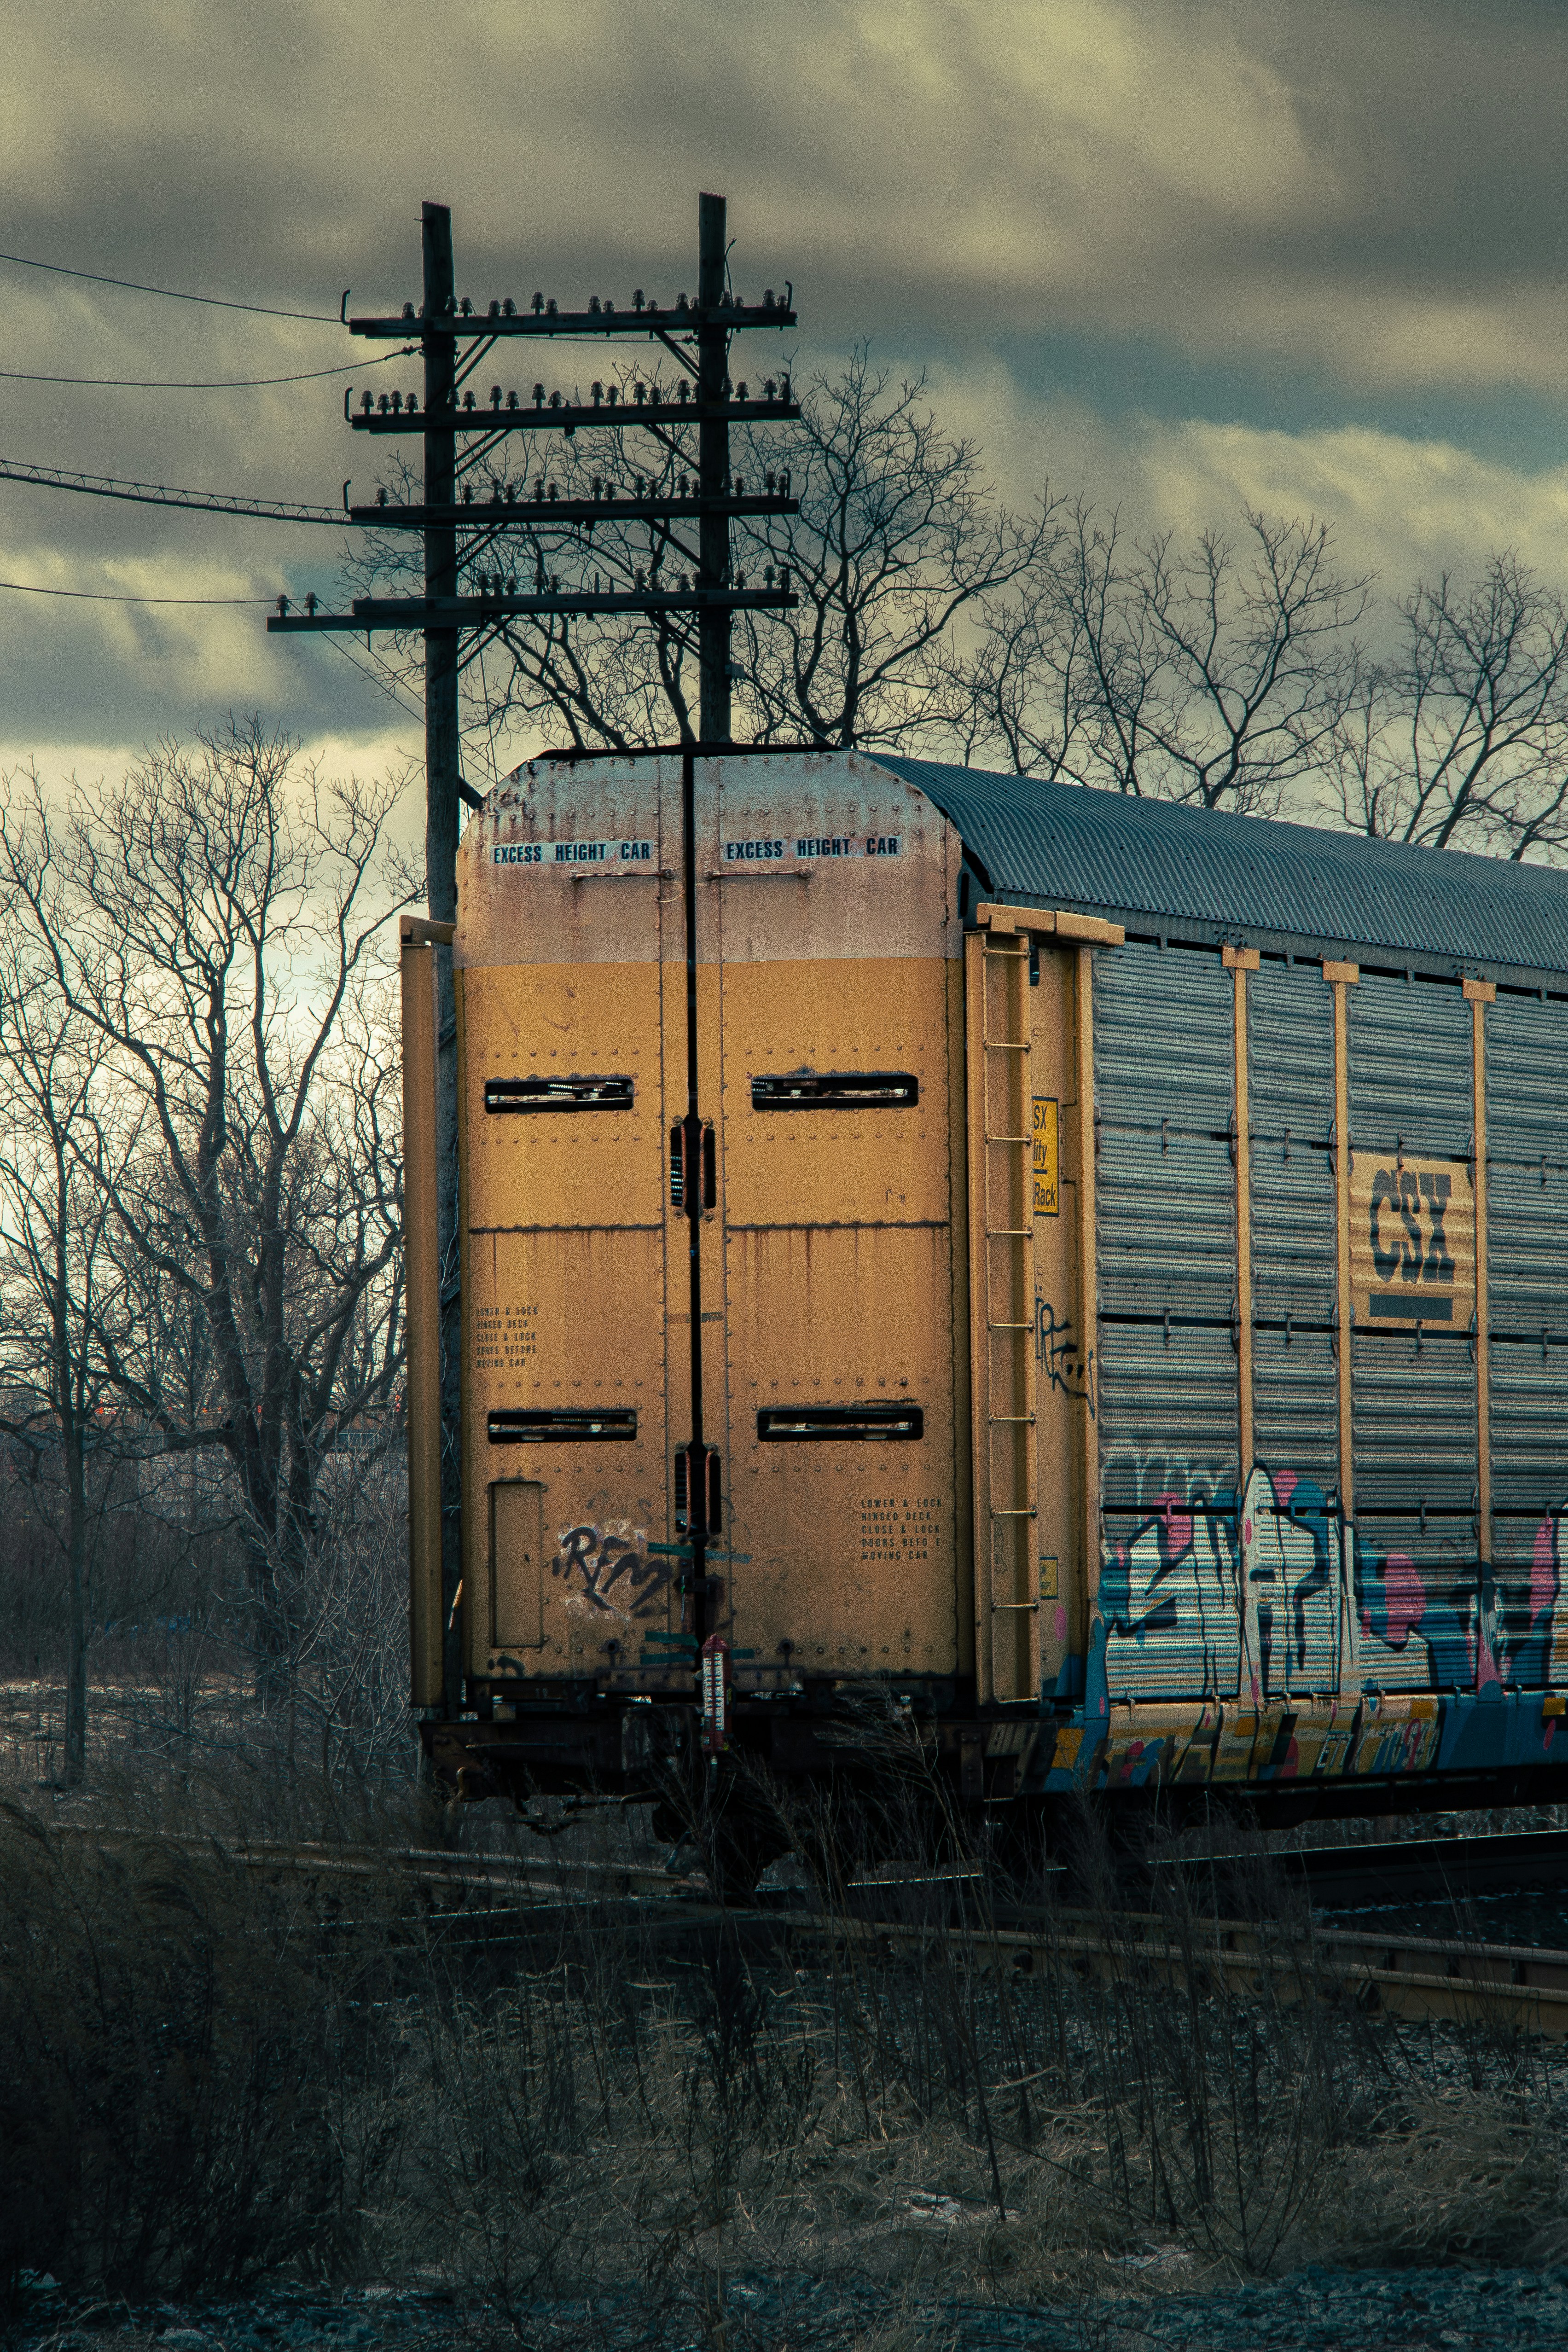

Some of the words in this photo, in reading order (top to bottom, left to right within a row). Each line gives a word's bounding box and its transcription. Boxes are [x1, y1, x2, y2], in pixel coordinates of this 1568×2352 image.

[494, 845, 542, 864] EXCESS
[555, 843, 606, 861] HEIGHT
[621, 842, 650, 859] CAR
[727, 840, 783, 859] EXCESS
[797, 838, 851, 856] HEIGHT
[866, 837, 898, 854] CAR
[1033, 1105, 1047, 1130] SX
[1369, 1169, 1456, 1284] CSX
[476, 1307, 499, 1316] LOWER
[505, 1307, 510, 1315] &
[516, 1306, 538, 1315] LOCK
[476, 1320, 502, 1329] HINGED
[507, 1319, 528, 1328] DECK
[476, 1333, 498, 1342] CLOSE
[514, 1332, 536, 1341] LOCK
[505, 1345, 537, 1354] BEFORE
[476, 1359, 504, 1367] MOVING
[509, 1359, 525, 1367] CAR
[861, 1499, 894, 1508] LOWER
[902, 1499, 908, 1508] &
[917, 1498, 942, 1507] LOCK
[861, 1512, 898, 1521] HINGED
[906, 1512, 931, 1520] DECK
[861, 1525, 894, 1534] CLOSE
[900, 1525, 906, 1534] &
[915, 1525, 940, 1533] LOCK
[861, 1538, 894, 1547] DOORS
[903, 1538, 941, 1546] BEFOE
[862, 1551, 901, 1560] MOVING
[908, 1551, 928, 1559] CAR
